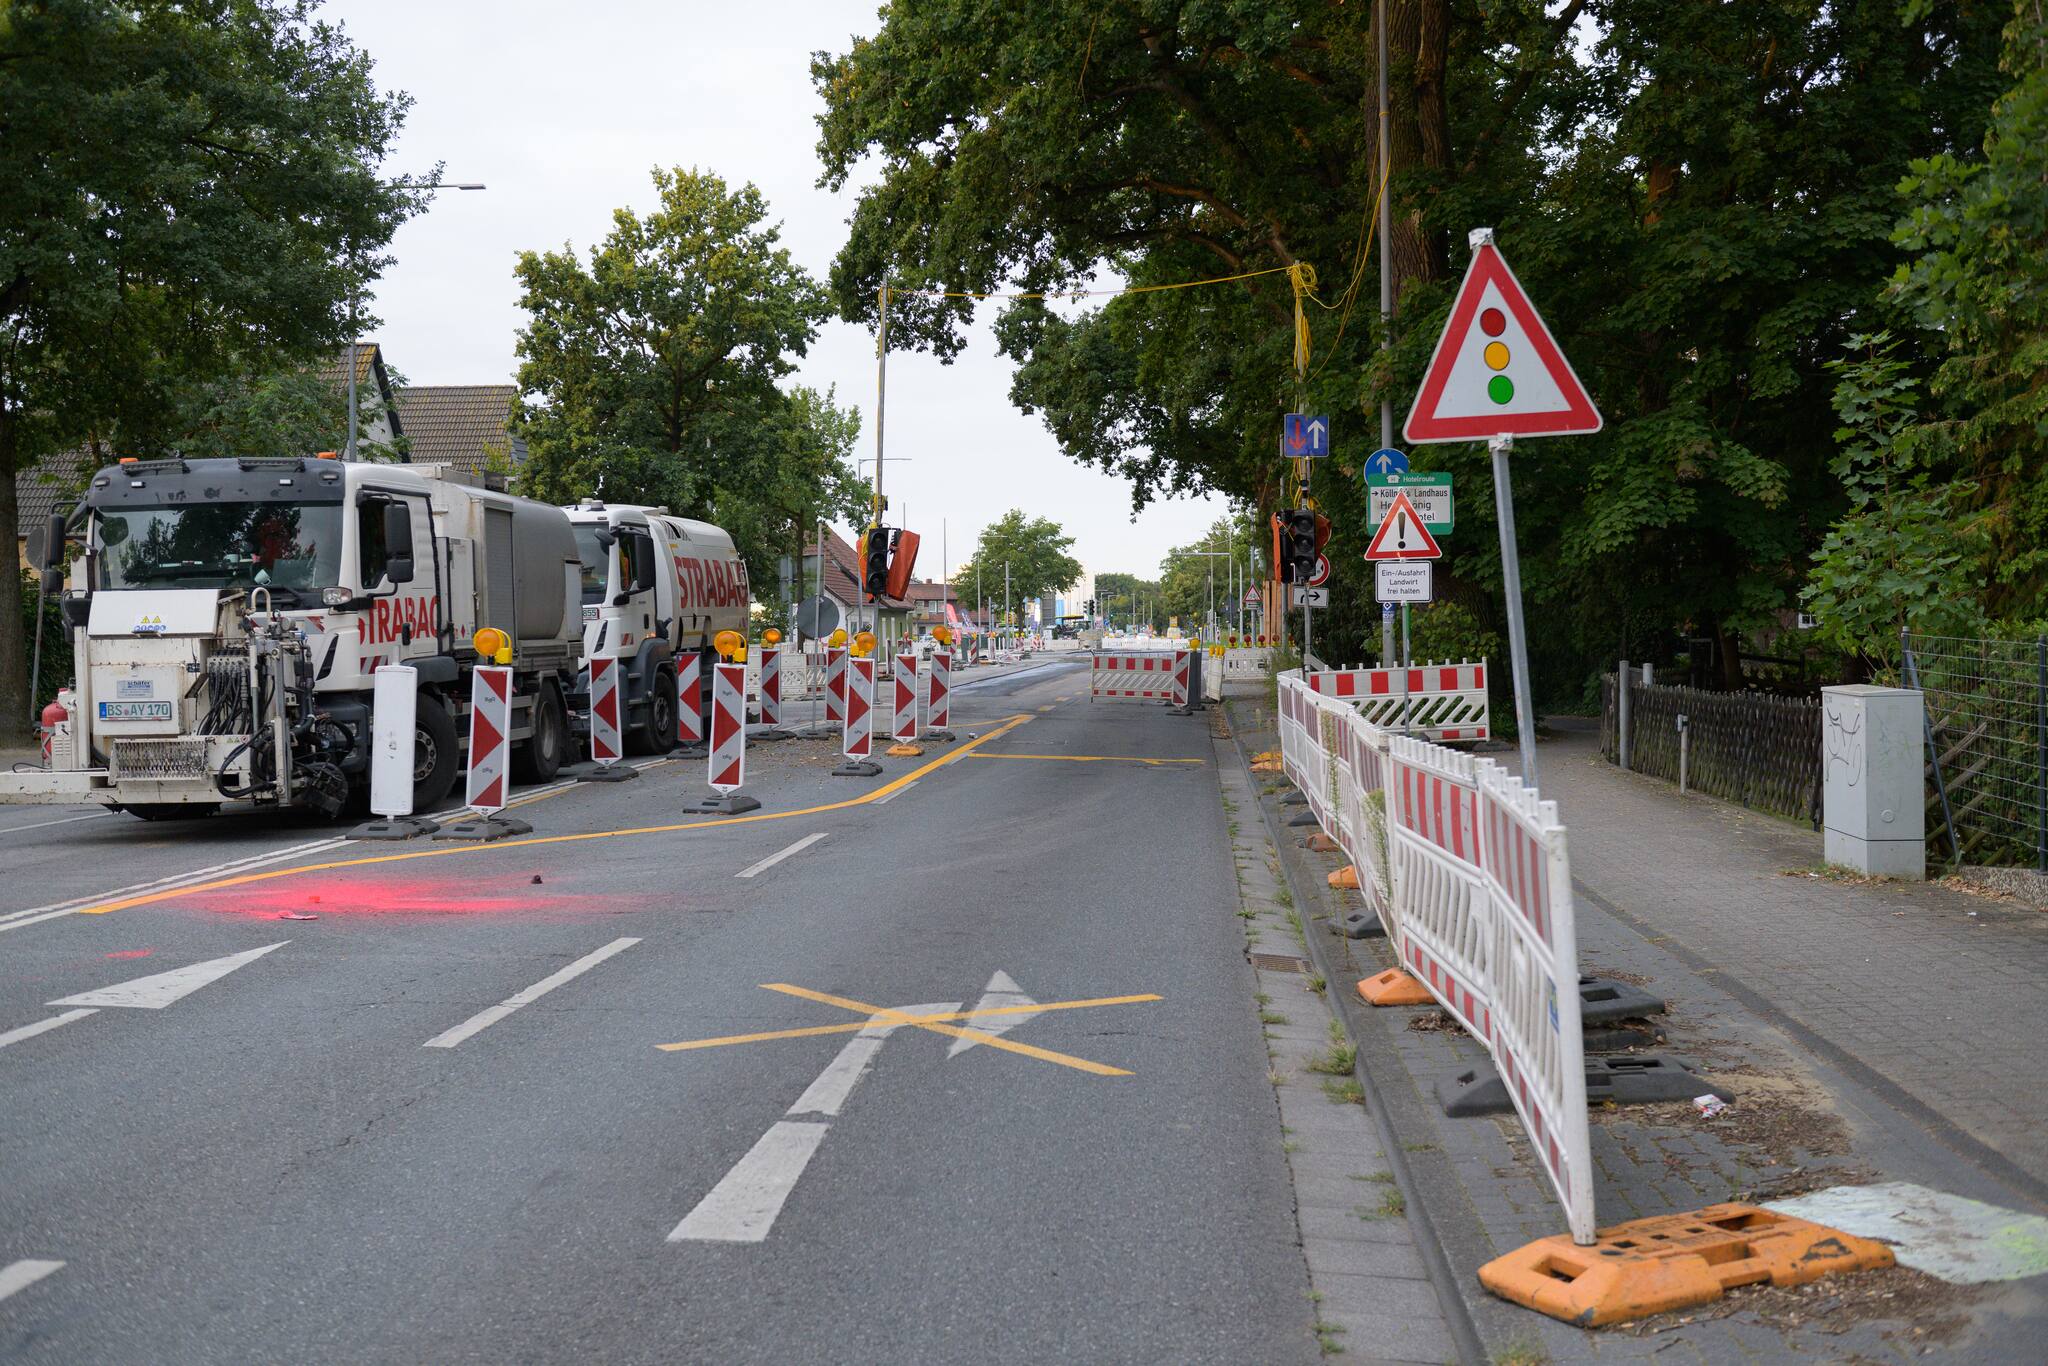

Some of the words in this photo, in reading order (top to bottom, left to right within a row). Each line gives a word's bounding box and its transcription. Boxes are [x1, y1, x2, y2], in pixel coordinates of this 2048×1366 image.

[1414, 488, 1448, 497] Landhaus
[1412, 500, 1432, 511] önig
[107, 704, 122, 716] BS
[131, 704, 145, 716] AY
[147, 704, 169, 716] 170
